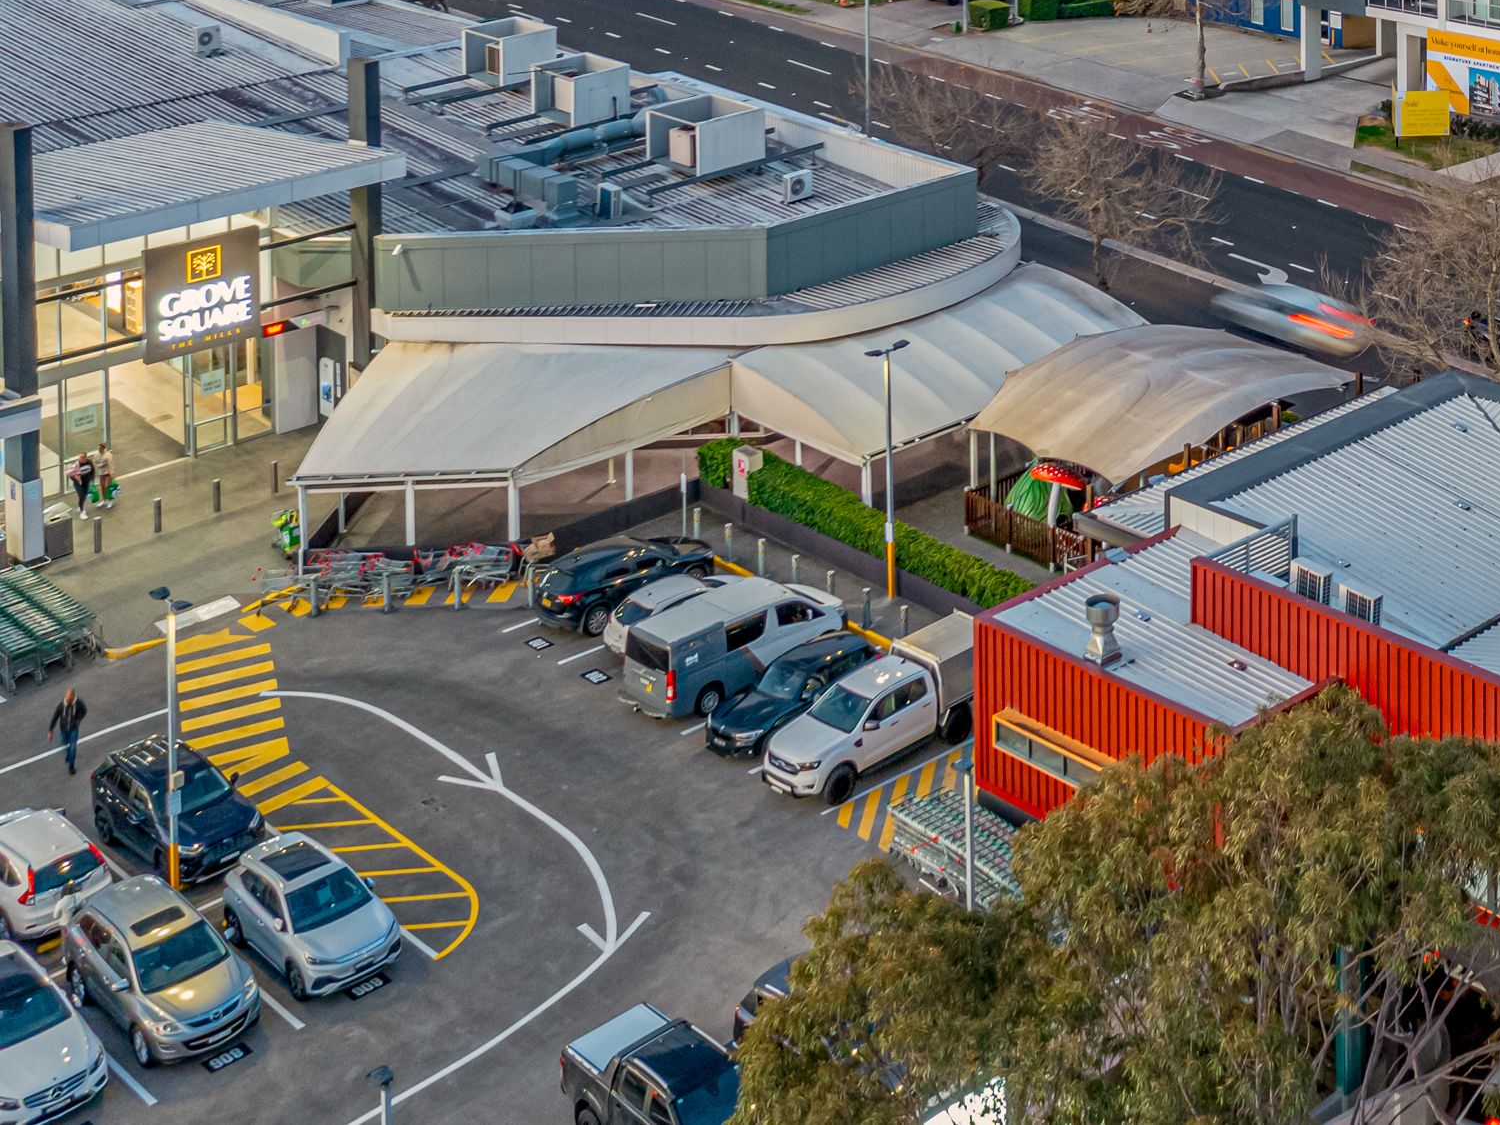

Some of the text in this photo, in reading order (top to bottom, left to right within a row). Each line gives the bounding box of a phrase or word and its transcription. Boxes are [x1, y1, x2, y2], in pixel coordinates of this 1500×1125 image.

[1430, 37, 1448, 47] Make
[1443, 55, 1471, 65] SIGNATURE
[159, 275, 251, 317] GROVE
[158, 299, 253, 341] SQUARE
[170, 327, 241, 350] THE HILLS
